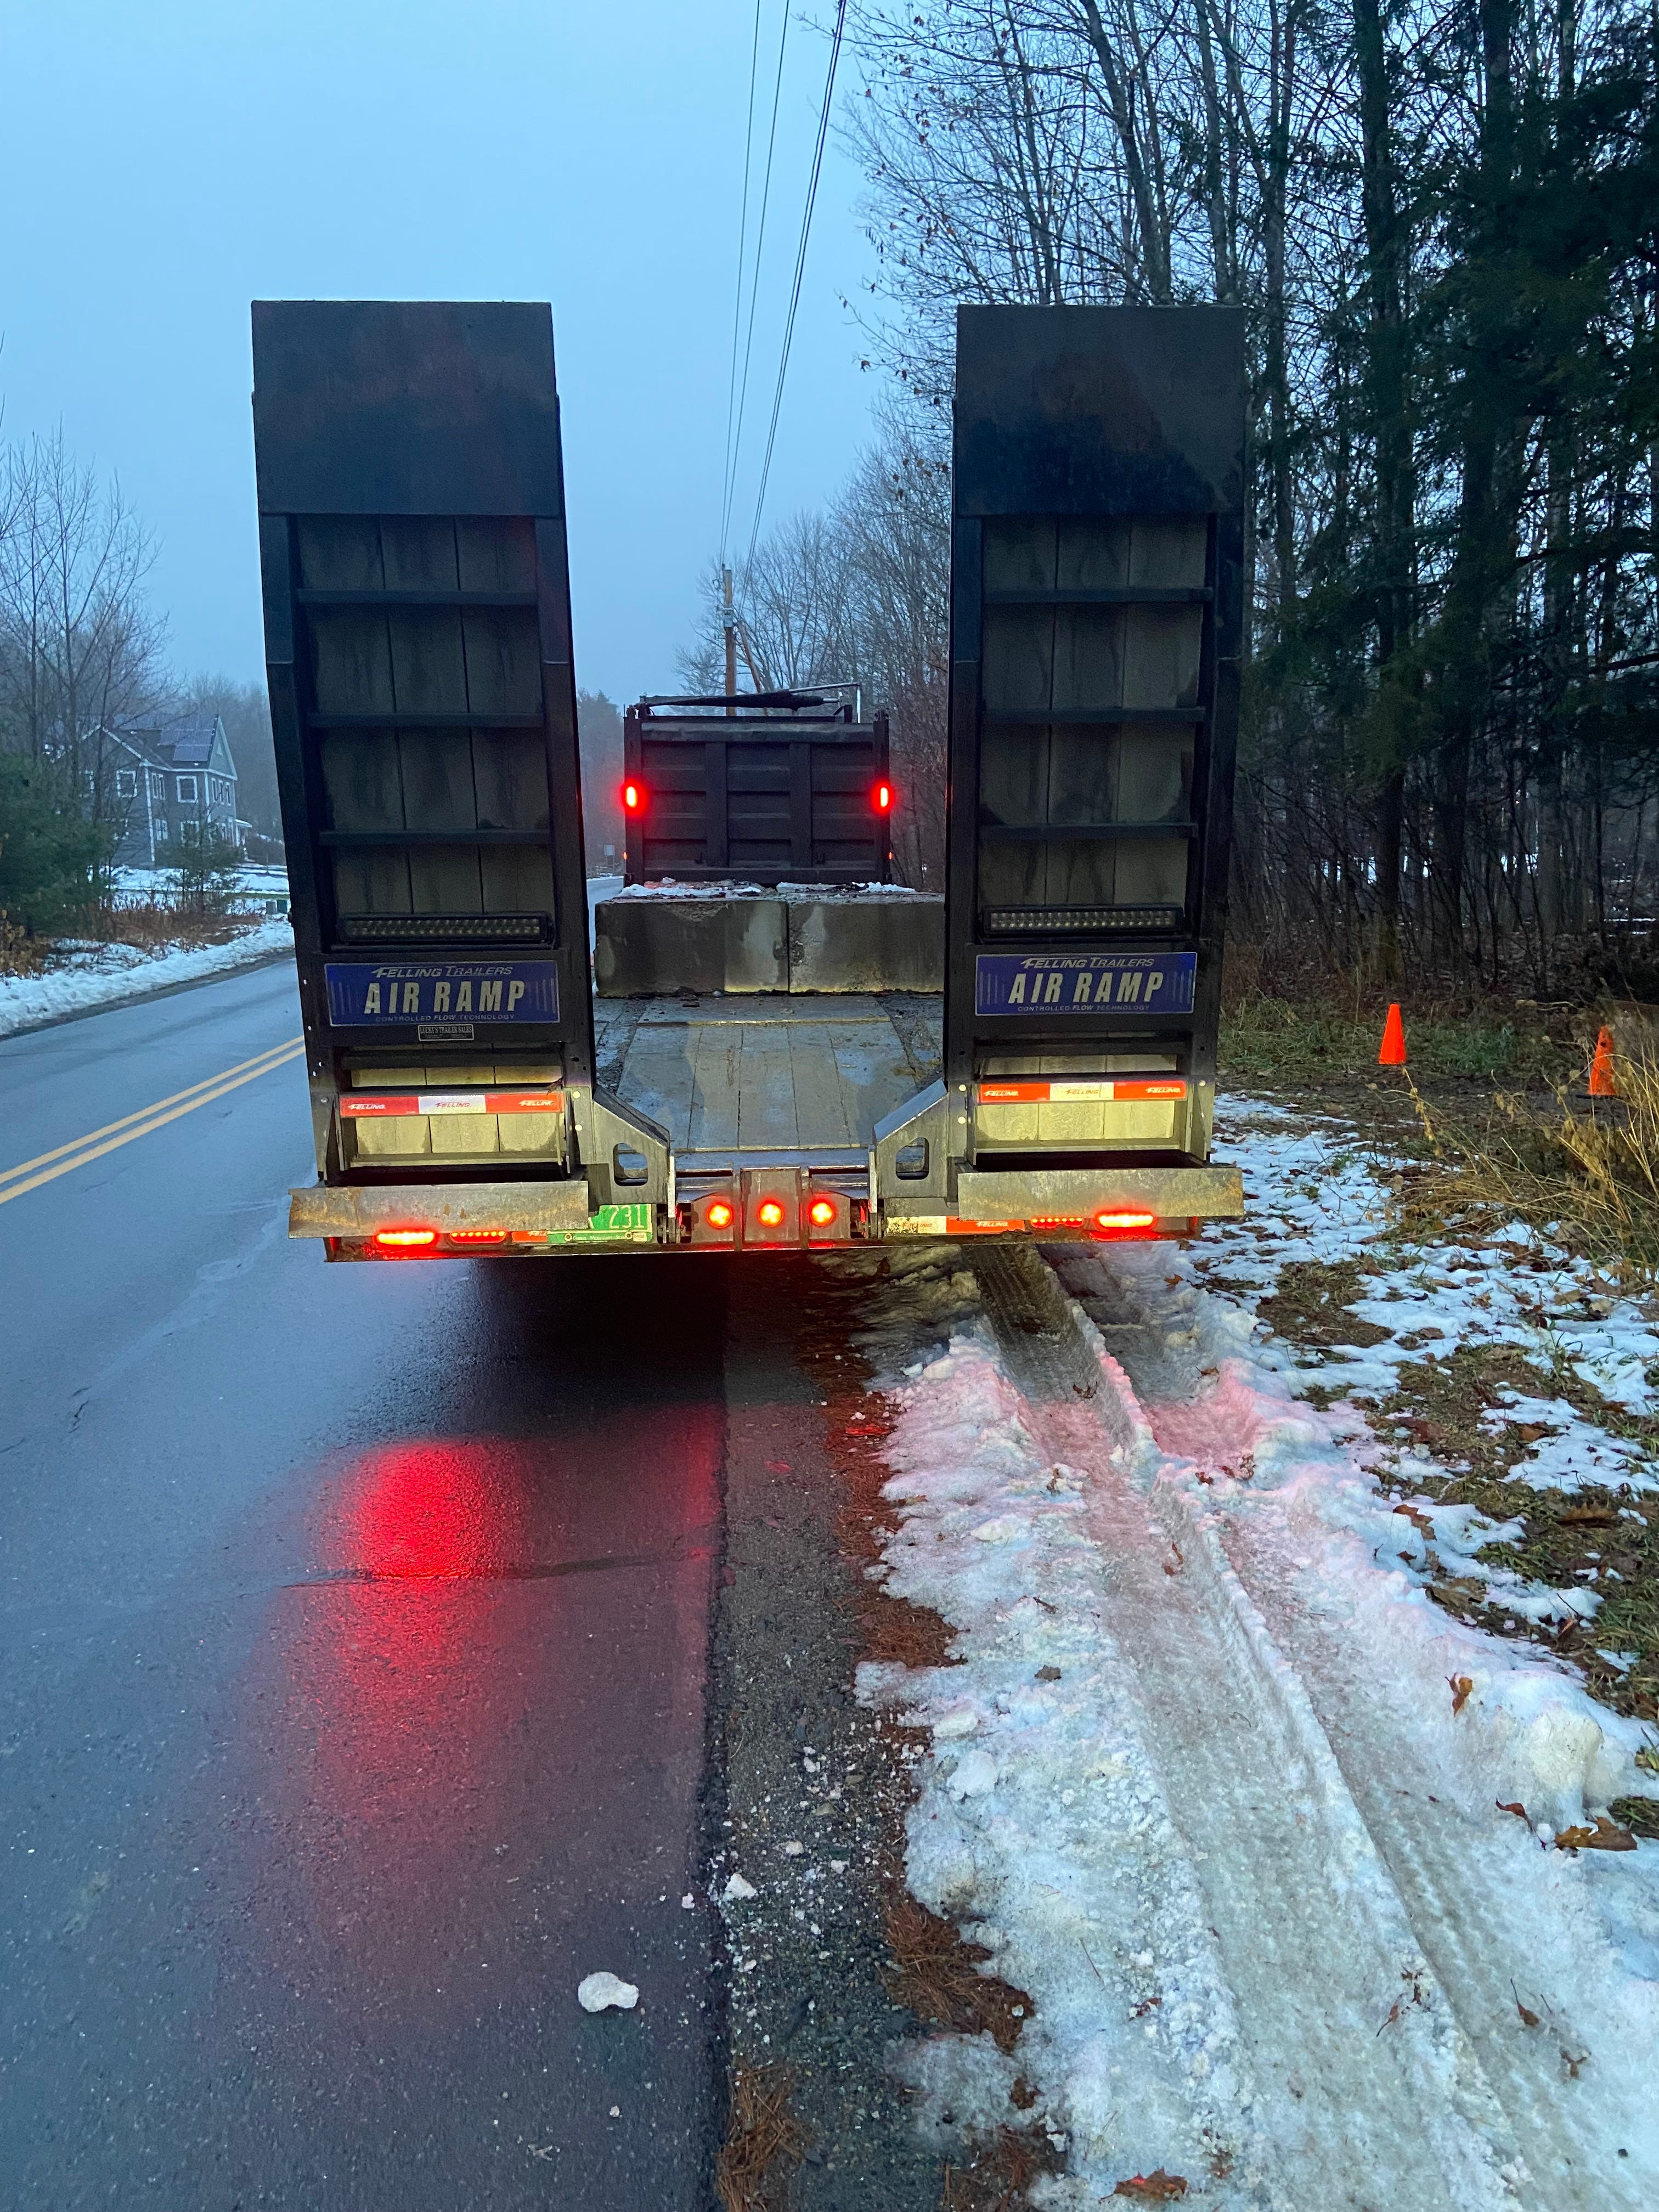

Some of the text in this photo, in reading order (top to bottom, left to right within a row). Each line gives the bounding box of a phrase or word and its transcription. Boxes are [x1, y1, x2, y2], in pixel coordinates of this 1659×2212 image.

[371, 966, 513, 978] FELLING TRAILERS
[1020, 957, 1155, 969] FELLING TRAILERS
[364, 980, 525, 1014] AIR RAMP
[1008, 972, 1164, 1003] AIR RAMP
[608, 1205, 645, 1228] 231
